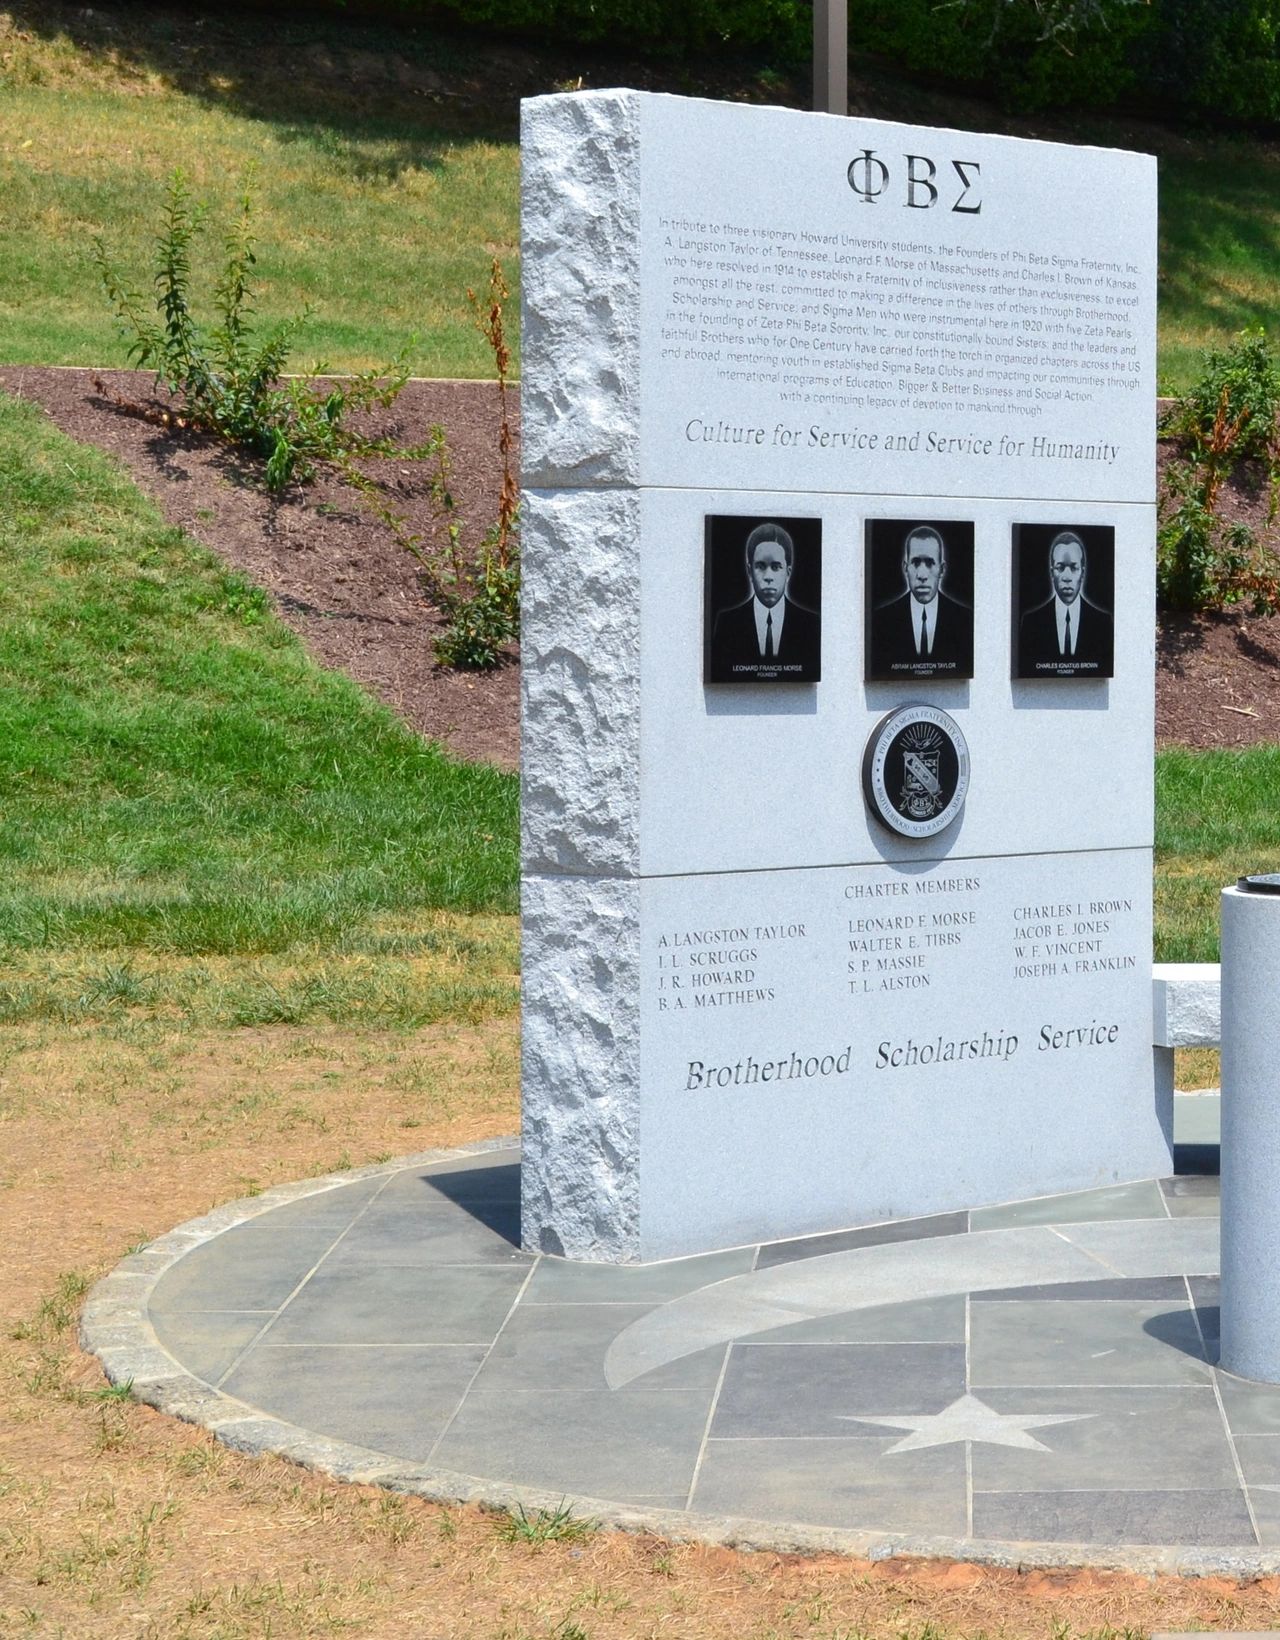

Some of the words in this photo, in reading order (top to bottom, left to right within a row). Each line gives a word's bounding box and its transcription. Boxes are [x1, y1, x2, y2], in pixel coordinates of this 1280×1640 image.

[658, 216, 669, 229] In
[670, 217, 707, 233] tribute
[722, 222, 750, 237] three
[800, 230, 839, 245] Howard
[840, 233, 889, 253] University
[955, 245, 998, 260] Founders
[1012, 250, 1027, 263] Phi
[1028, 252, 1050, 265] Beta
[1051, 254, 1079, 271] Sigma
[678, 236, 727, 256] Langston
[728, 241, 760, 259] Taylor
[834, 251, 873, 266] Leonard
[884, 255, 915, 270] Morse
[930, 260, 1000, 277] Massachusetts
[1021, 268, 1056, 282] Charles
[1064, 272, 1093, 286] Brown
[1105, 276, 1137, 290] Kansas
[690, 256, 713, 270] here
[715, 258, 760, 274] resolved
[773, 263, 795, 277] 1914
[810, 266, 855, 282] establish
[865, 271, 911, 289] Fraternity
[925, 276, 987, 293] inclusiveness
[988, 282, 1017, 296] rather
[1017, 285, 1039, 298] than
[1115, 293, 1139, 306] excel
[672, 272, 719, 291] amongst
[781, 282, 835, 298] committed
[850, 287, 886, 305] making
[895, 291, 944, 307] difference
[1008, 301, 1038, 314] others
[1040, 303, 1074, 320] through
[672, 291, 733, 311] Scholarship
[822, 303, 854, 320] Sigma
[856, 305, 877, 319] Men
[902, 312, 927, 323] were
[928, 311, 987, 327] instrumental
[988, 316, 1009, 329] here
[1021, 319, 1043, 332] 1920
[1084, 324, 1104, 336] Zeta
[1105, 325, 1133, 338] Pearls
[698, 311, 745, 330] founding
[760, 316, 784, 330] Zeta
[785, 318, 802, 331] Phi
[803, 319, 828, 333] Beta
[912, 327, 983, 347] constitutionally
[985, 333, 1014, 346] bound
[1086, 340, 1119, 354] leaders
[660, 327, 698, 342] faithful
[700, 330, 745, 345] Brothers
[789, 336, 811, 349] One
[812, 338, 852, 355] Century
[854, 341, 877, 354] have
[879, 342, 913, 356] carried
[915, 345, 940, 358] forth
[958, 348, 983, 361] torch
[994, 350, 1039, 368] organized
[1040, 354, 1079, 370] chapters
[1080, 359, 1110, 370] across
[1127, 360, 1141, 372] US
[715, 367, 780, 383] international
[782, 374, 830, 389] programs
[898, 378, 929, 395] Bigger
[931, 381, 939, 393] &
[941, 381, 971, 394] Better
[972, 383, 1014, 397] Business
[726, 350, 779, 368] mentoring
[781, 353, 810, 370] youth
[823, 356, 879, 371] established
[881, 360, 912, 376] Sigma
[914, 362, 936, 375] Beta
[937, 364, 965, 377] Clubs
[985, 367, 1031, 384] impacting
[1049, 371, 1106, 386] communities
[1107, 375, 1140, 391] through
[812, 391, 865, 409] continuing
[866, 394, 898, 410] legacy
[912, 397, 953, 411] devotion
[966, 400, 1006, 413] mankind
[1007, 402, 1043, 418] through
[686, 419, 765, 444] Culture
[772, 424, 802, 446] for
[808, 425, 878, 449] Service
[885, 431, 920, 451] and
[926, 431, 992, 455] Service
[997, 435, 1025, 456] for
[1031, 437, 1120, 465] Humanity
[845, 883, 909, 899] CHARTER
[916, 878, 980, 894] MEMBERS
[1014, 904, 1071, 920] CHARLES
[1090, 900, 1131, 914] BROWN
[849, 916, 912, 933] LEONARD
[933, 911, 976, 926] MORSE
[1014, 925, 1051, 940] JACOB
[1072, 921, 1109, 935] JONES
[674, 928, 749, 946] LANGSTON
[754, 924, 807, 939] TAYLOR
[849, 937, 902, 952] WALTER
[925, 932, 961, 946] TIBBS
[690, 948, 757, 966] SCRUGGS
[1046, 940, 1102, 955] VINCENT
[877, 955, 925, 971] MASSIE
[1014, 963, 1056, 979] JOSEPH
[1076, 956, 1135, 972] FRANKLIN
[692, 970, 754, 987] HOWARD
[880, 974, 930, 991] ALSTON
[695, 988, 774, 1008] MATTHEWS
[683, 1046, 851, 1091] Brotherhood
[876, 1029, 1018, 1069] Scholarship
[1038, 1020, 1118, 1051] Service
